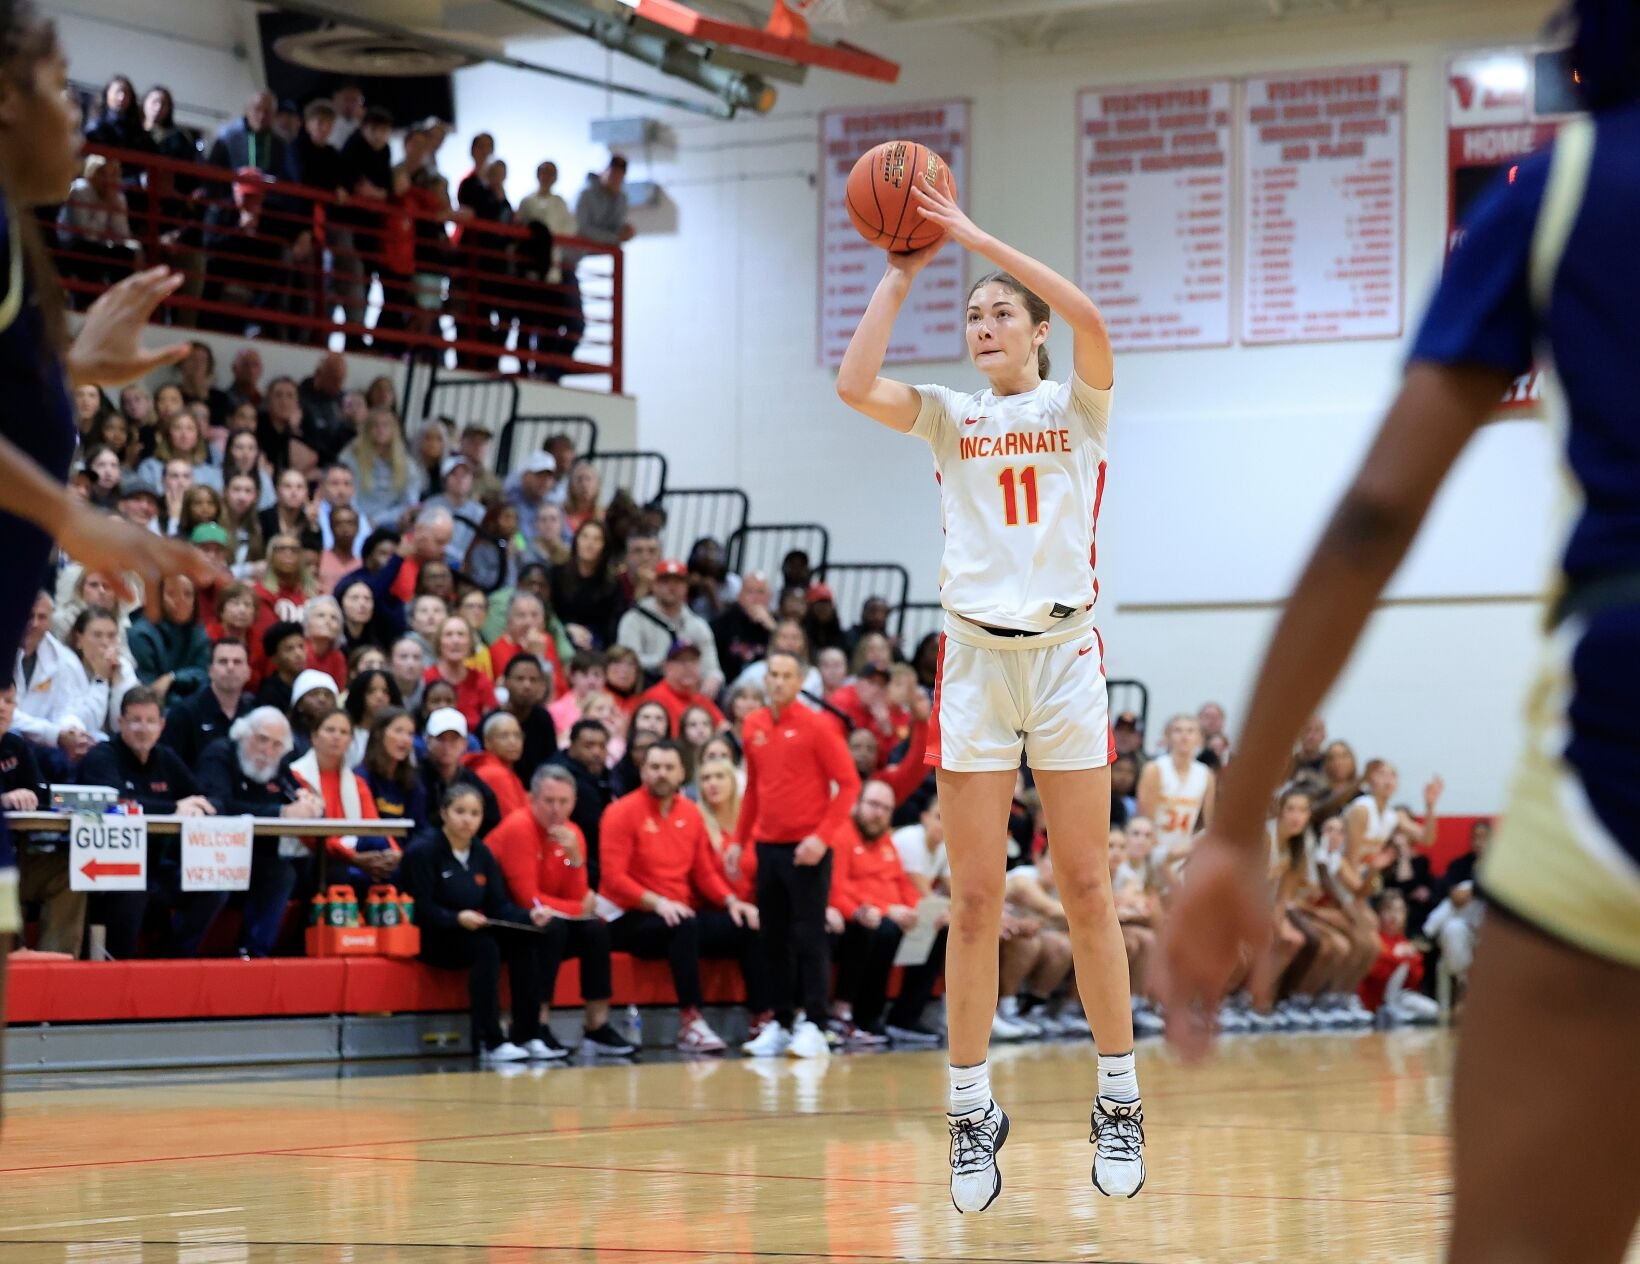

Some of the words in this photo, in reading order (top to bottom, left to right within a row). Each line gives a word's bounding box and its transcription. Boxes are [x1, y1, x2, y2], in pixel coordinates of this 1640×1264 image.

[1463, 127, 1535, 161] HOME
[960, 429, 1072, 460] INCARNATE
[998, 464, 1040, 526] 11
[75, 827, 142, 849] GUEST
[187, 831, 247, 848] WELCOME
